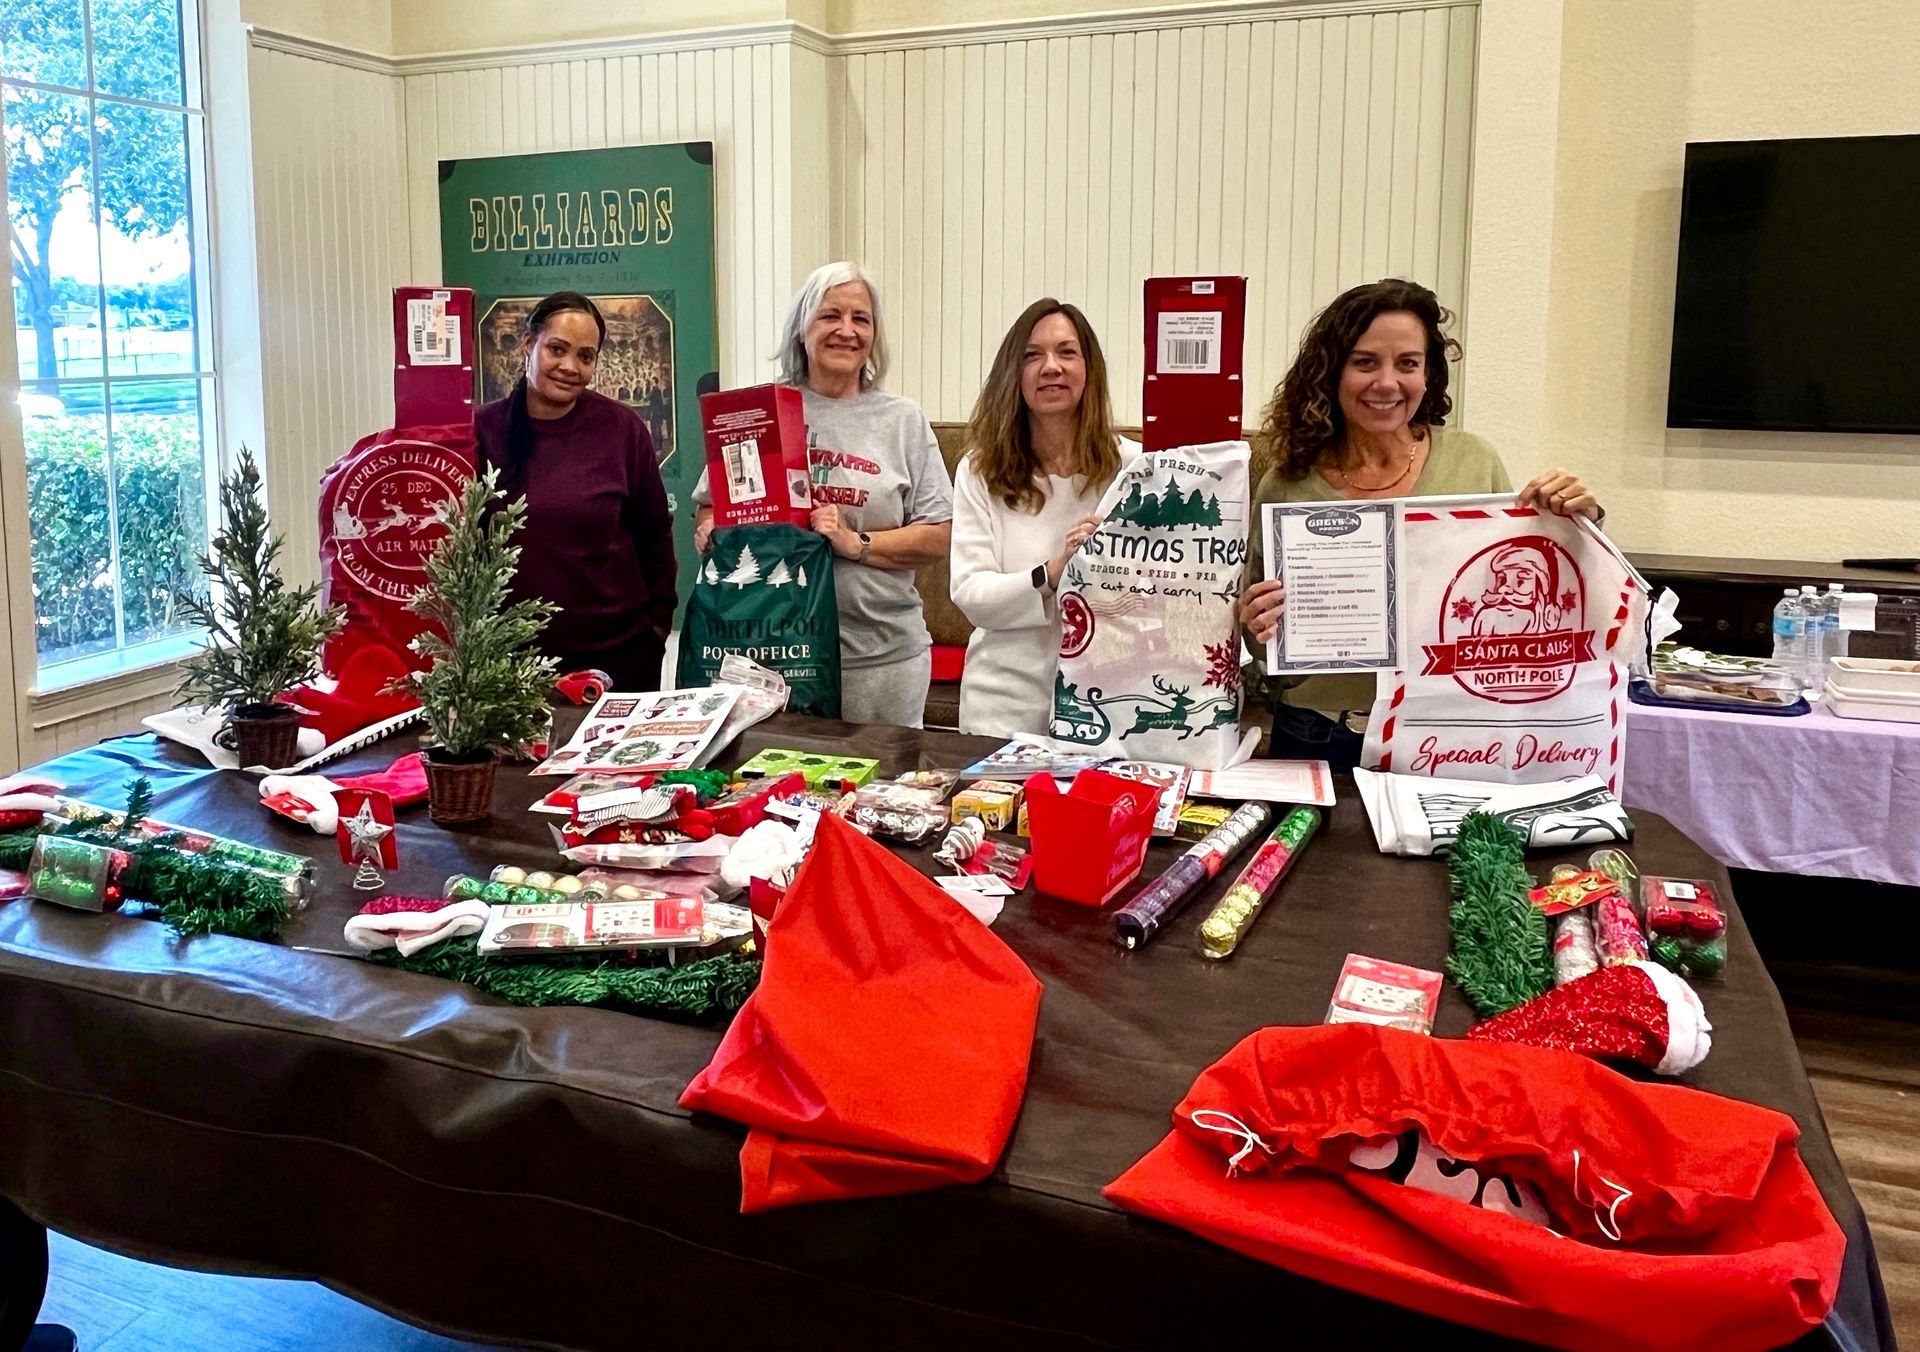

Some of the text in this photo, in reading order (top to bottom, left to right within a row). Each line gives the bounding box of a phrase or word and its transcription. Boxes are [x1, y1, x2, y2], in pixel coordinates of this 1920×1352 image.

[470, 187, 674, 252] BILLIARDS
[523, 251, 621, 267] EXHIBITION
[1159, 458, 1206, 476] FRESH
[346, 452, 467, 502] EXPRESS DELIVER
[382, 482, 432, 494] 25 DEC
[376, 541, 402, 552] AIR
[342, 543, 376, 583] FROM
[1100, 581, 1202, 605] cut and carry
[746, 644, 811, 660] OFFICE
[1464, 639, 1570, 660] SANTA CLAUS
[1474, 668, 1565, 686] NORTH POLE
[1411, 734, 1602, 777] Special Delivery
